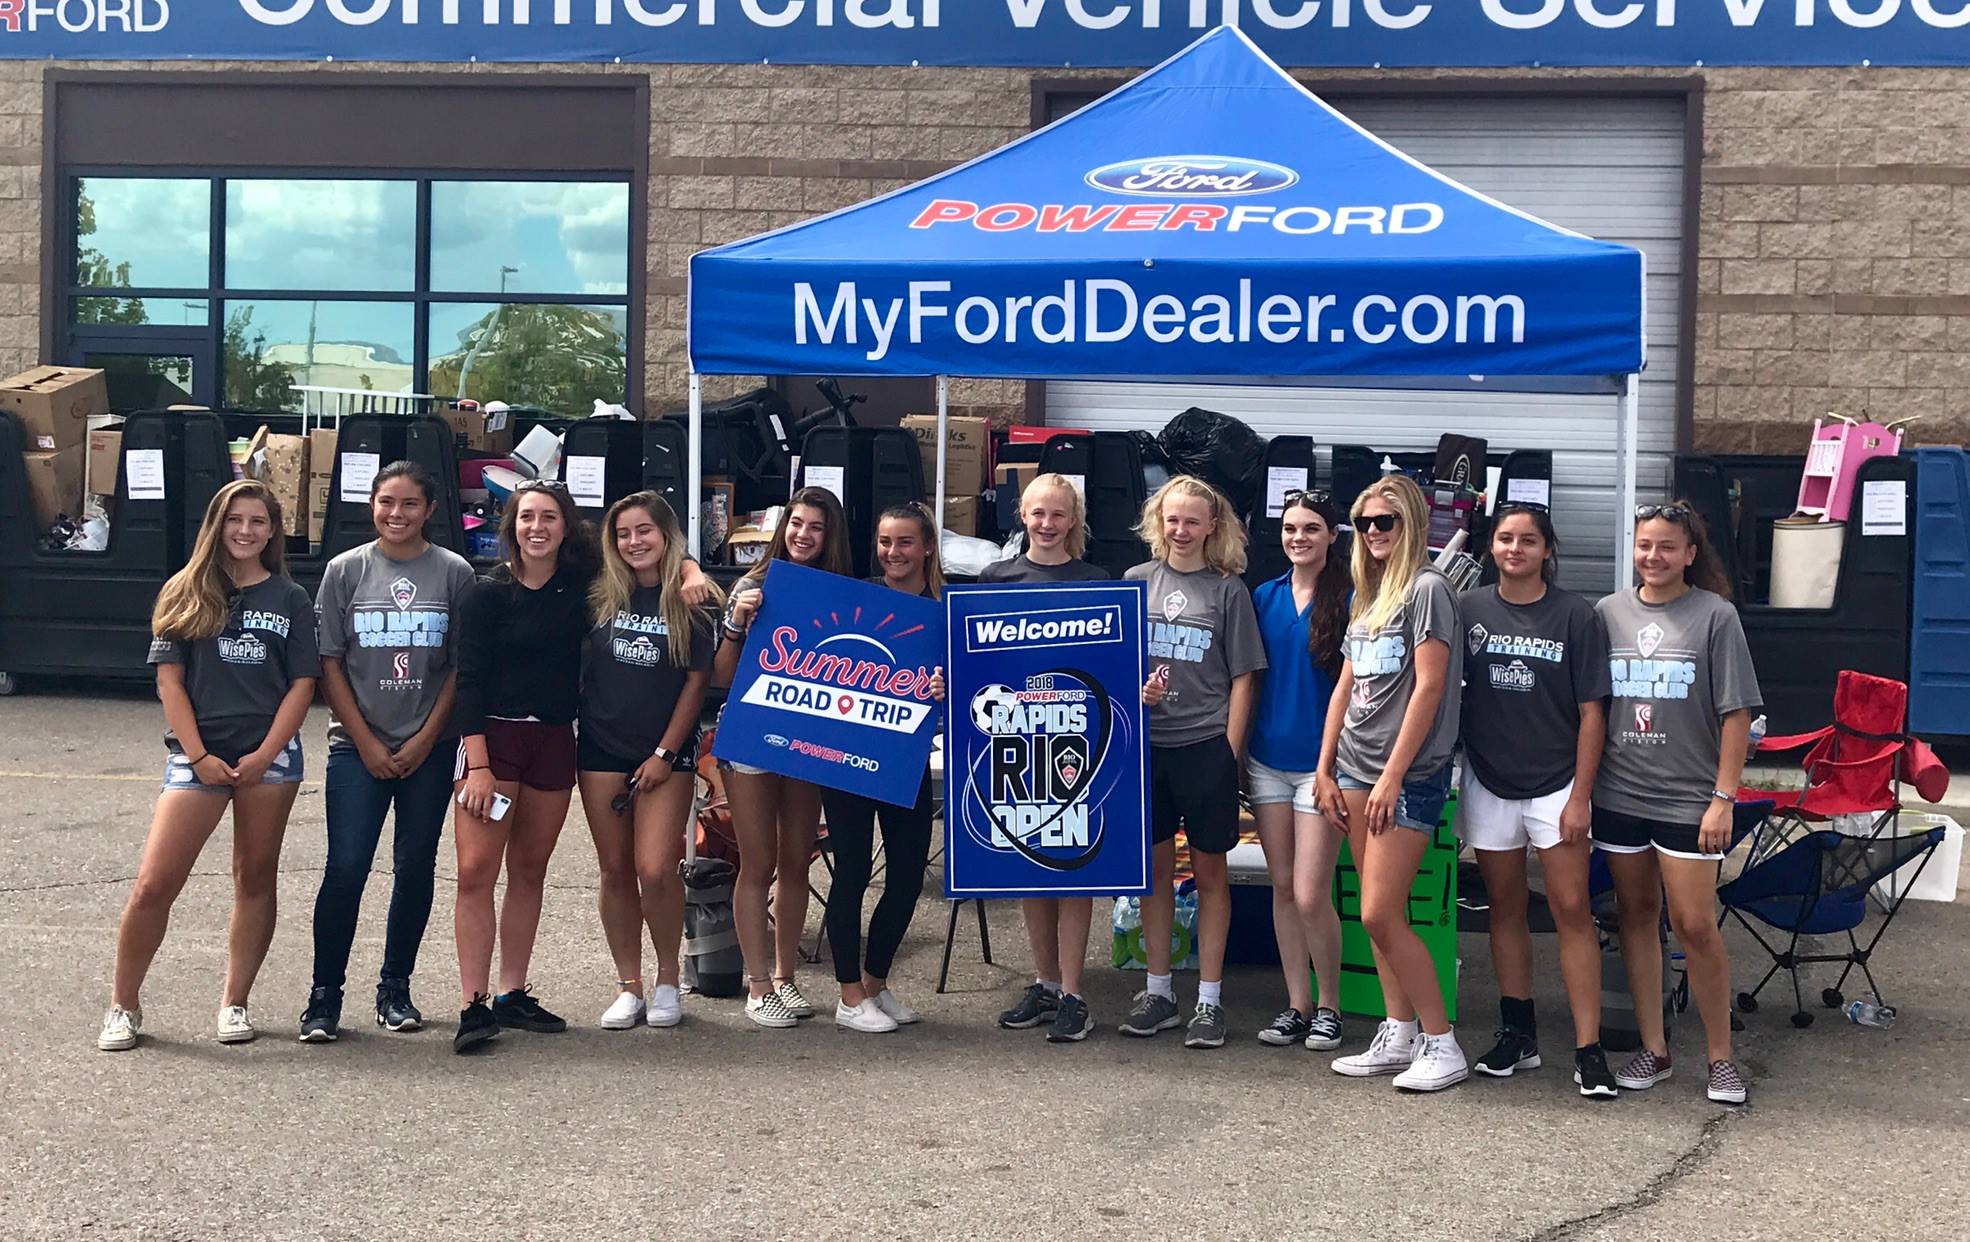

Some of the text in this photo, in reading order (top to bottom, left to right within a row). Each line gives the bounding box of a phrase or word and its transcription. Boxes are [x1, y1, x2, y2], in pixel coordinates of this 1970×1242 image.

[1122, 160, 1258, 192] Ford
[908, 198, 1445, 236] POWERFORD
[793, 278, 1526, 361] MyFordDealer.com
[915, 427, 967, 442] Dirks
[243, 610, 291, 629] RAPIDS
[244, 619, 289, 637] INING
[354, 611, 449, 633] RIO RAPIDS
[617, 610, 667, 626] RIO RAP
[975, 612, 1113, 644] Welcome!
[220, 639, 265, 659] WisePies
[359, 631, 443, 648] SOCCER CLUB
[1488, 634, 1565, 652] RIO RAPIDS
[614, 640, 659, 661] WisePies
[1490, 644, 1559, 661] TRAINING
[758, 626, 933, 700] Summer
[1611, 659, 1696, 685] IO RAPIDS
[1026, 675, 1054, 691] 2018
[1491, 666, 1533, 686] WisePies
[1015, 690, 1087, 703] POWERFORD
[1612, 680, 1652, 698] OCCER
[765, 681, 912, 726] ROAD TRIP
[991, 703, 1088, 735] RAPIDS
[1622, 731, 1666, 739] COLEMAN
[789, 739, 880, 773] POWERFORD
[990, 734, 1090, 805] RIO
[991, 804, 1089, 848] OPEN
